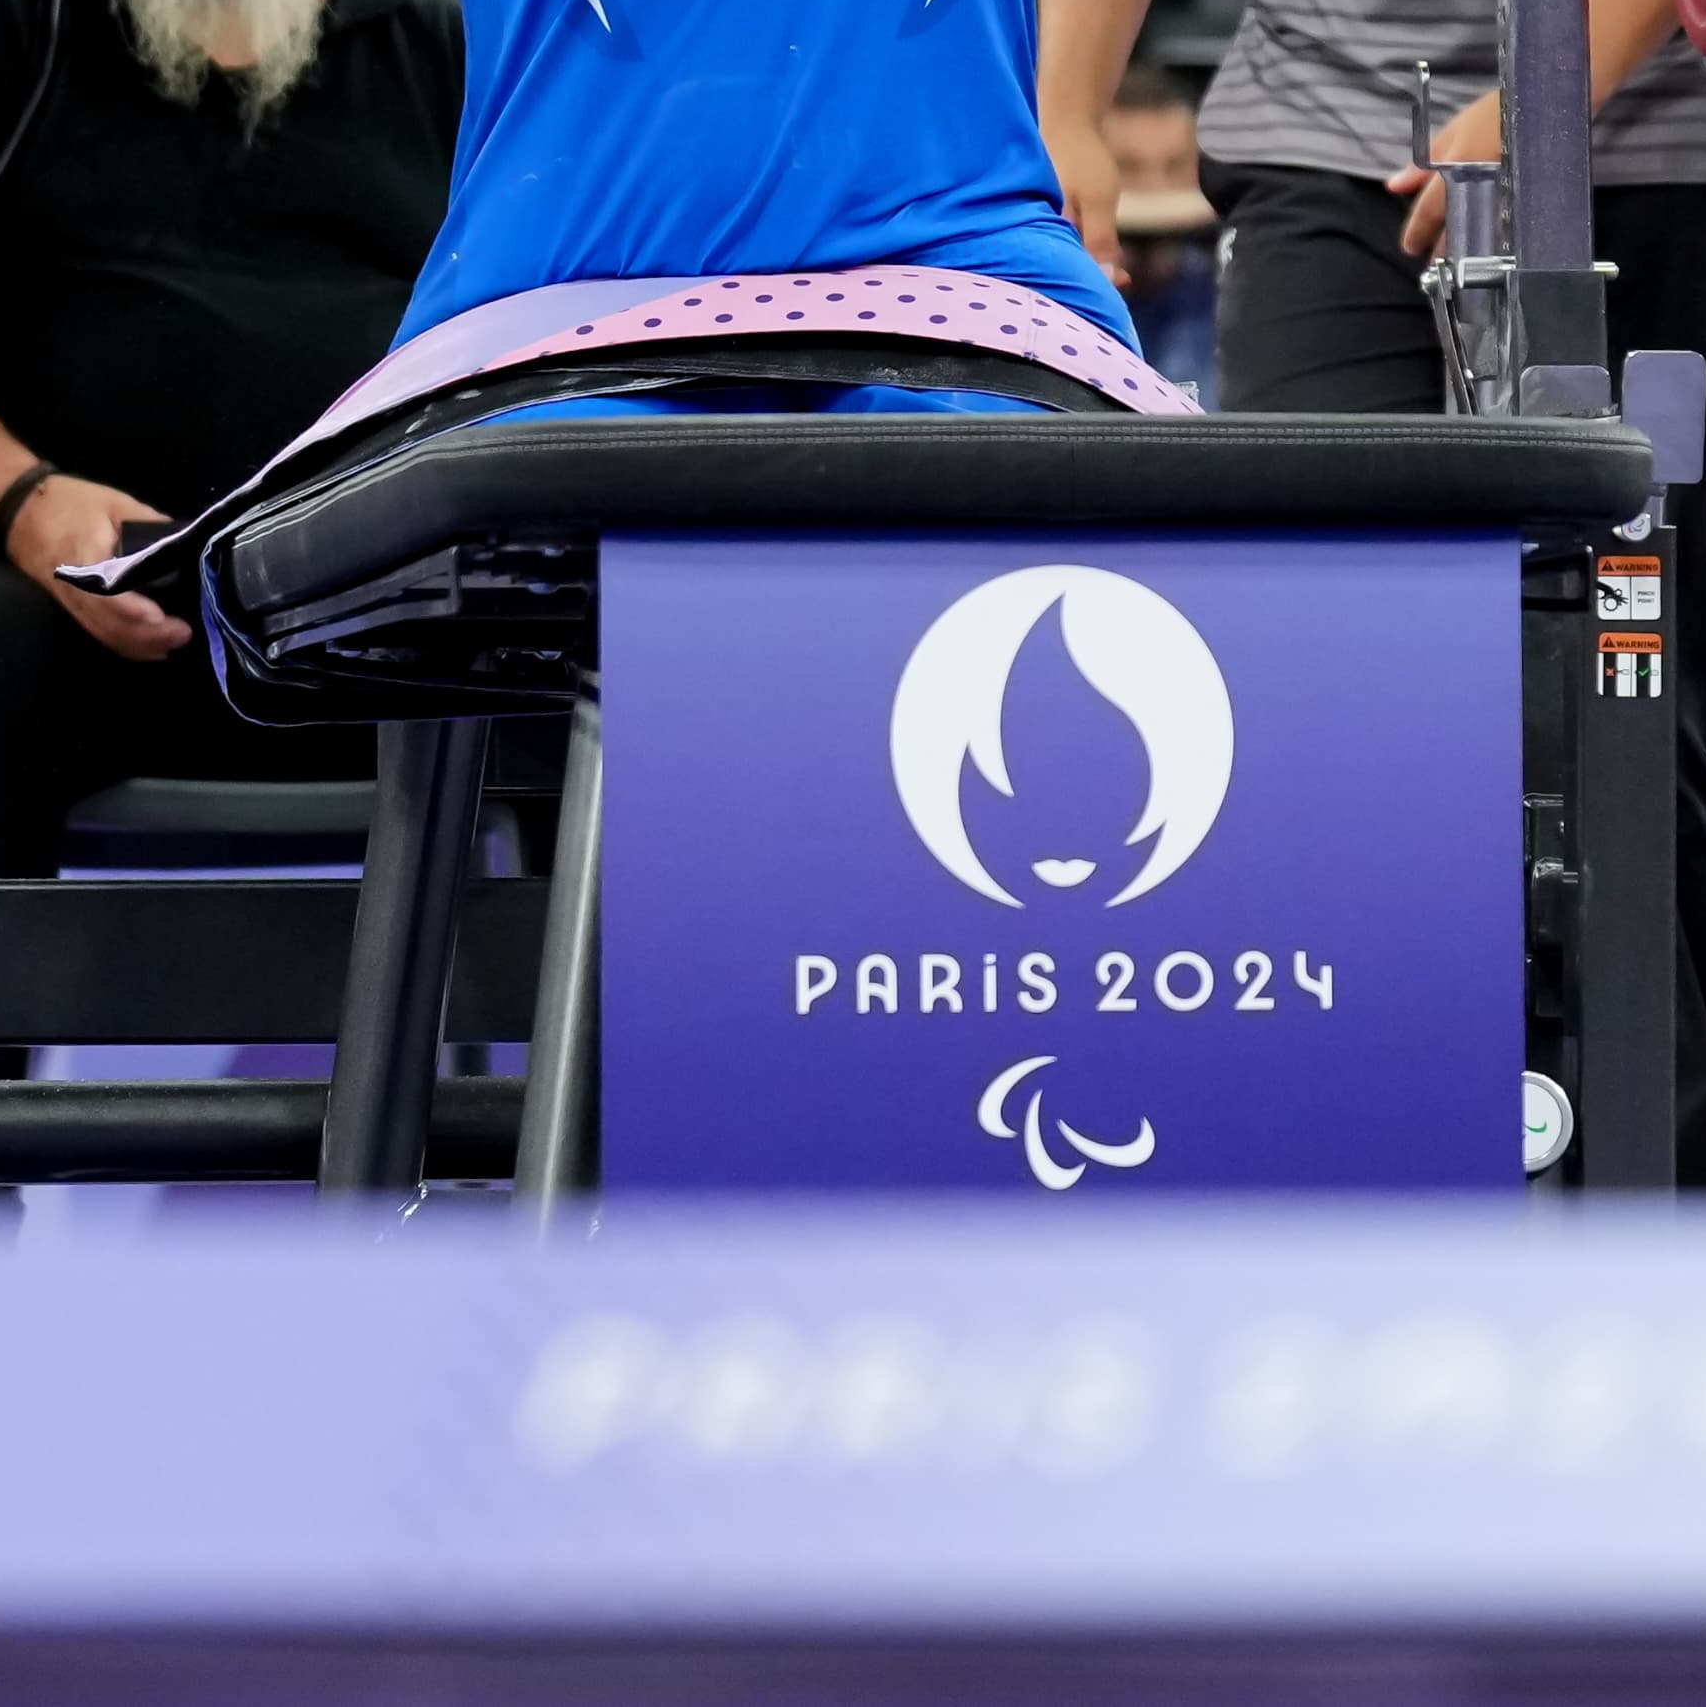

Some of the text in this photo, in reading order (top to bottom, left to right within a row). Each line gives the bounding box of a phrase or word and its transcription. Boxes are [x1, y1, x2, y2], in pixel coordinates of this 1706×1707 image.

[1615, 563, 1659, 572] WARNING
[1615, 640, 1660, 649] WARNING
[1094, 949, 1334, 1012] 2024
